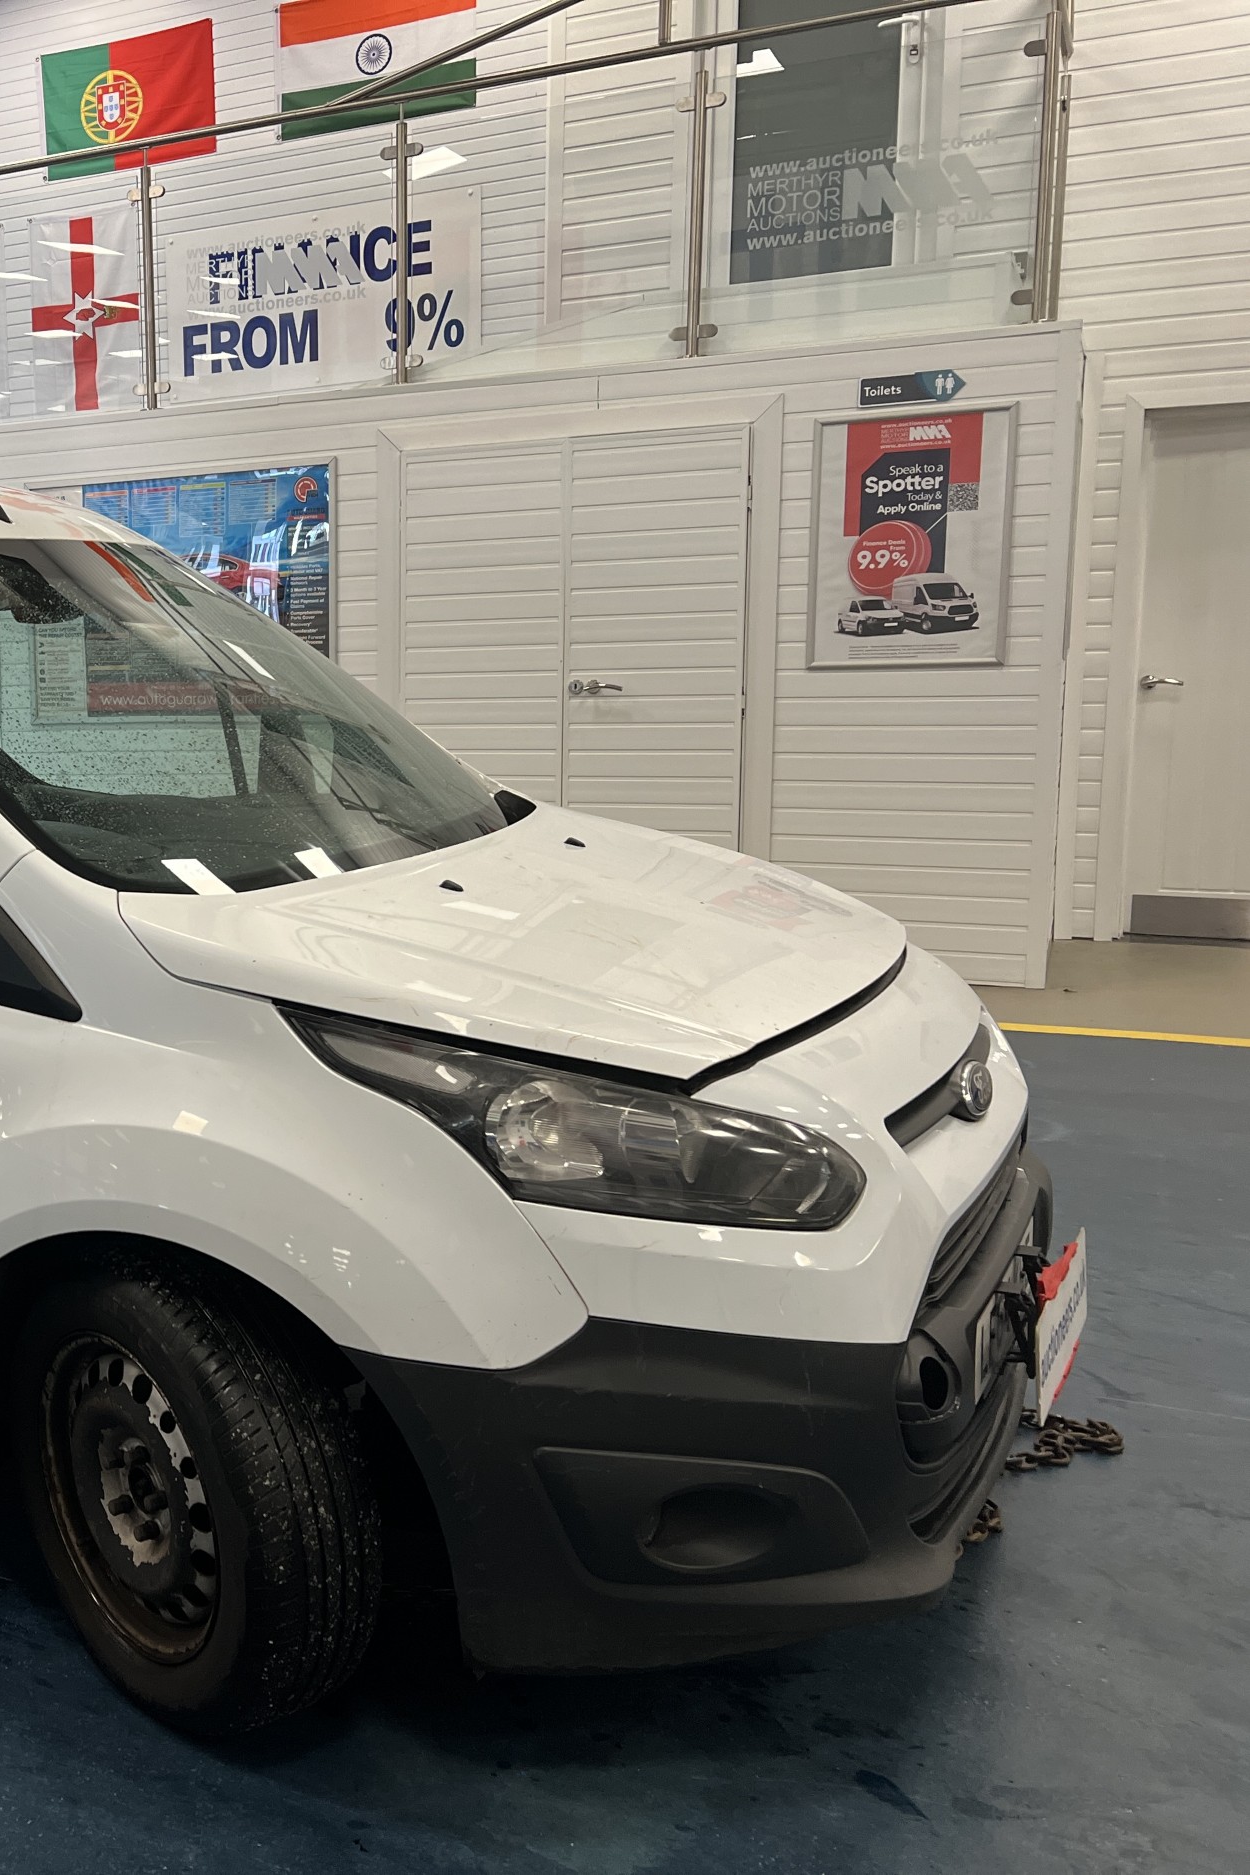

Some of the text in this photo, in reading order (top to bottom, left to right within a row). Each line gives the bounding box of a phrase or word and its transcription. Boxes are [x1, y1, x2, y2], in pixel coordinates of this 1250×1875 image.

[747, 171, 842, 197] MERTHYR
[747, 187, 840, 217] MOTOR
[747, 208, 841, 232] AUCTIONS
[183, 309, 319, 377] FROM
[863, 385, 902, 397] Toilets
[889, 464, 944, 477] Speak to a
[865, 474, 944, 497] Spotter
[906, 491, 943, 502] Today &
[877, 502, 942, 516] Apply Online
[857, 549, 908, 570] 9.9%
